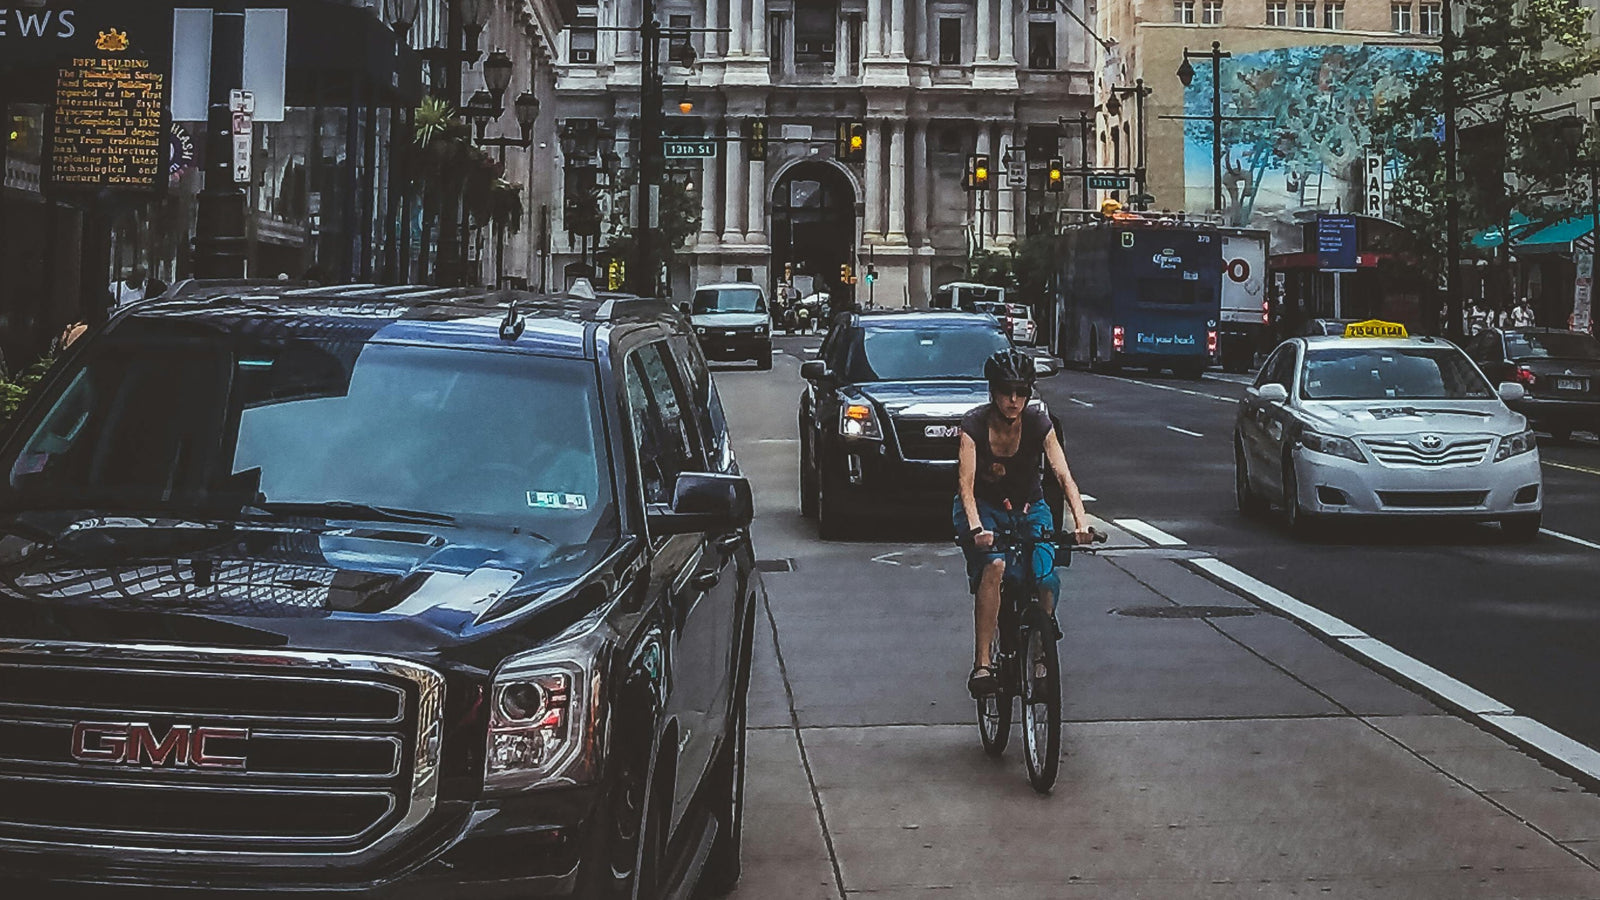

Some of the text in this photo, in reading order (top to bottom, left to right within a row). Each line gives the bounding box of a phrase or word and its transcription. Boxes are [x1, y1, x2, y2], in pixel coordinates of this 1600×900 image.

[101, 59, 149, 69] BUILDING
[59, 69, 74, 78] The
[79, 70, 131, 80] Philadelphia
[82, 80, 114, 90] Society
[118, 80, 152, 91] Building
[57, 89, 98, 98] regarded
[121, 90, 136, 98] the
[142, 90, 162, 99] first
[56, 98, 123, 107] International
[107, 108, 128, 117] built
[132, 108, 142, 117] in
[146, 108, 161, 117] the
[74, 117, 121, 127] Completed
[125, 118, 134, 126] in
[96, 127, 126, 136] radical
[80, 136, 103, 144] from
[109, 137, 159, 146] traditional
[671, 145, 710, 154] 13th St
[108, 155, 124, 164] the
[132, 156, 158, 165] latest
[52, 164, 158, 174] technological and
[51, 174, 100, 182] structural
[1368, 158, 1381, 217] PAR
[1137, 332, 1195, 347] Find your beach
[924, 425, 961, 437] GM
[71, 720, 249, 768] GMC
